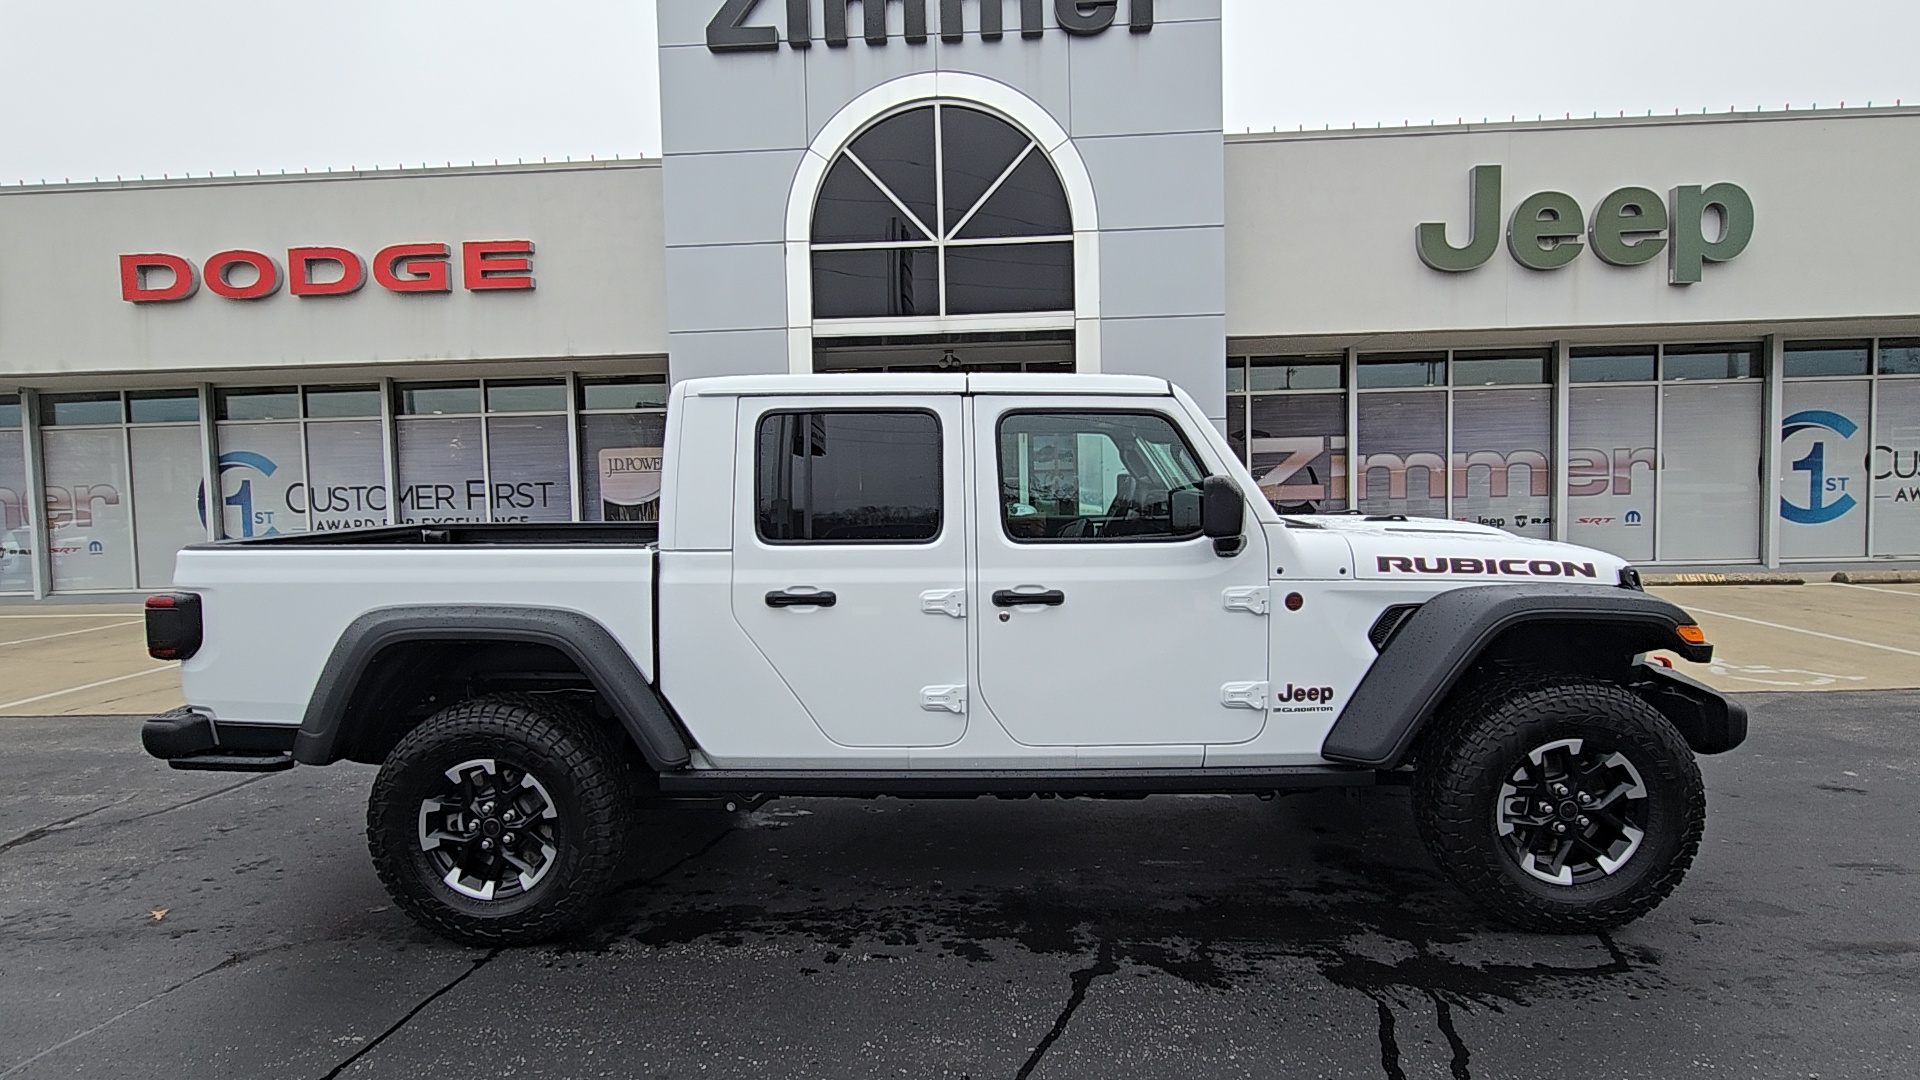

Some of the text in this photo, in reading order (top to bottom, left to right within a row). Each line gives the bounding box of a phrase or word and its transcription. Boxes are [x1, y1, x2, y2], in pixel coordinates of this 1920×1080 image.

[1415, 164, 1755, 287] Jeep
[119, 239, 536, 303] DODGE
[1250, 434, 1665, 501] Zimmer
[1864, 445, 1920, 480] CU
[285, 482, 456, 514] CUSTOMER
[1472, 515, 1505, 528] Jeep
[1575, 517, 1616, 525] SRT
[1376, 556, 1598, 578] RUBICON
[1277, 683, 1334, 704] Jeep
